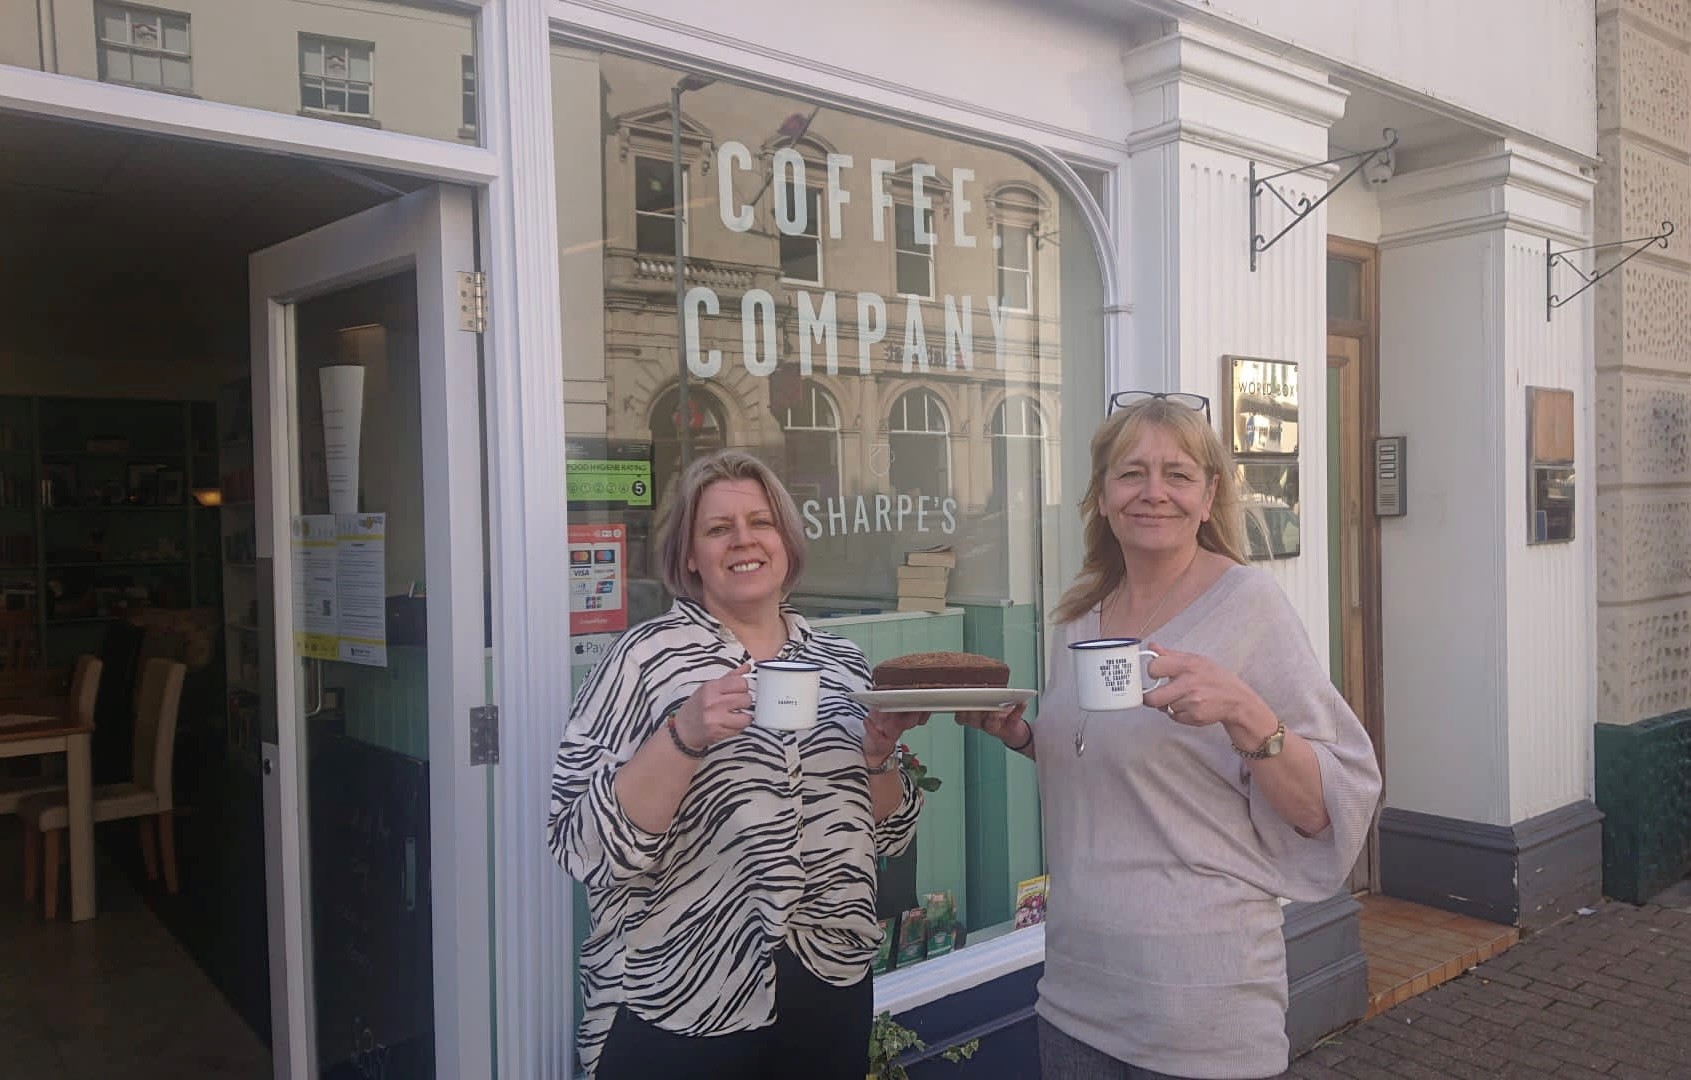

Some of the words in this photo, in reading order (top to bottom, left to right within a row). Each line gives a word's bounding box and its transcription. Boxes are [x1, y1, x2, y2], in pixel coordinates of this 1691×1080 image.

[684, 286, 1011, 378] COMPANY
[1238, 382, 1272, 396] WORLD
[567, 463, 589, 471] FOOD
[635, 482, 643, 495] 5
[802, 494, 957, 540] SHARPE'S
[573, 569, 590, 577] VISA
[586, 641, 605, 656] Pay
